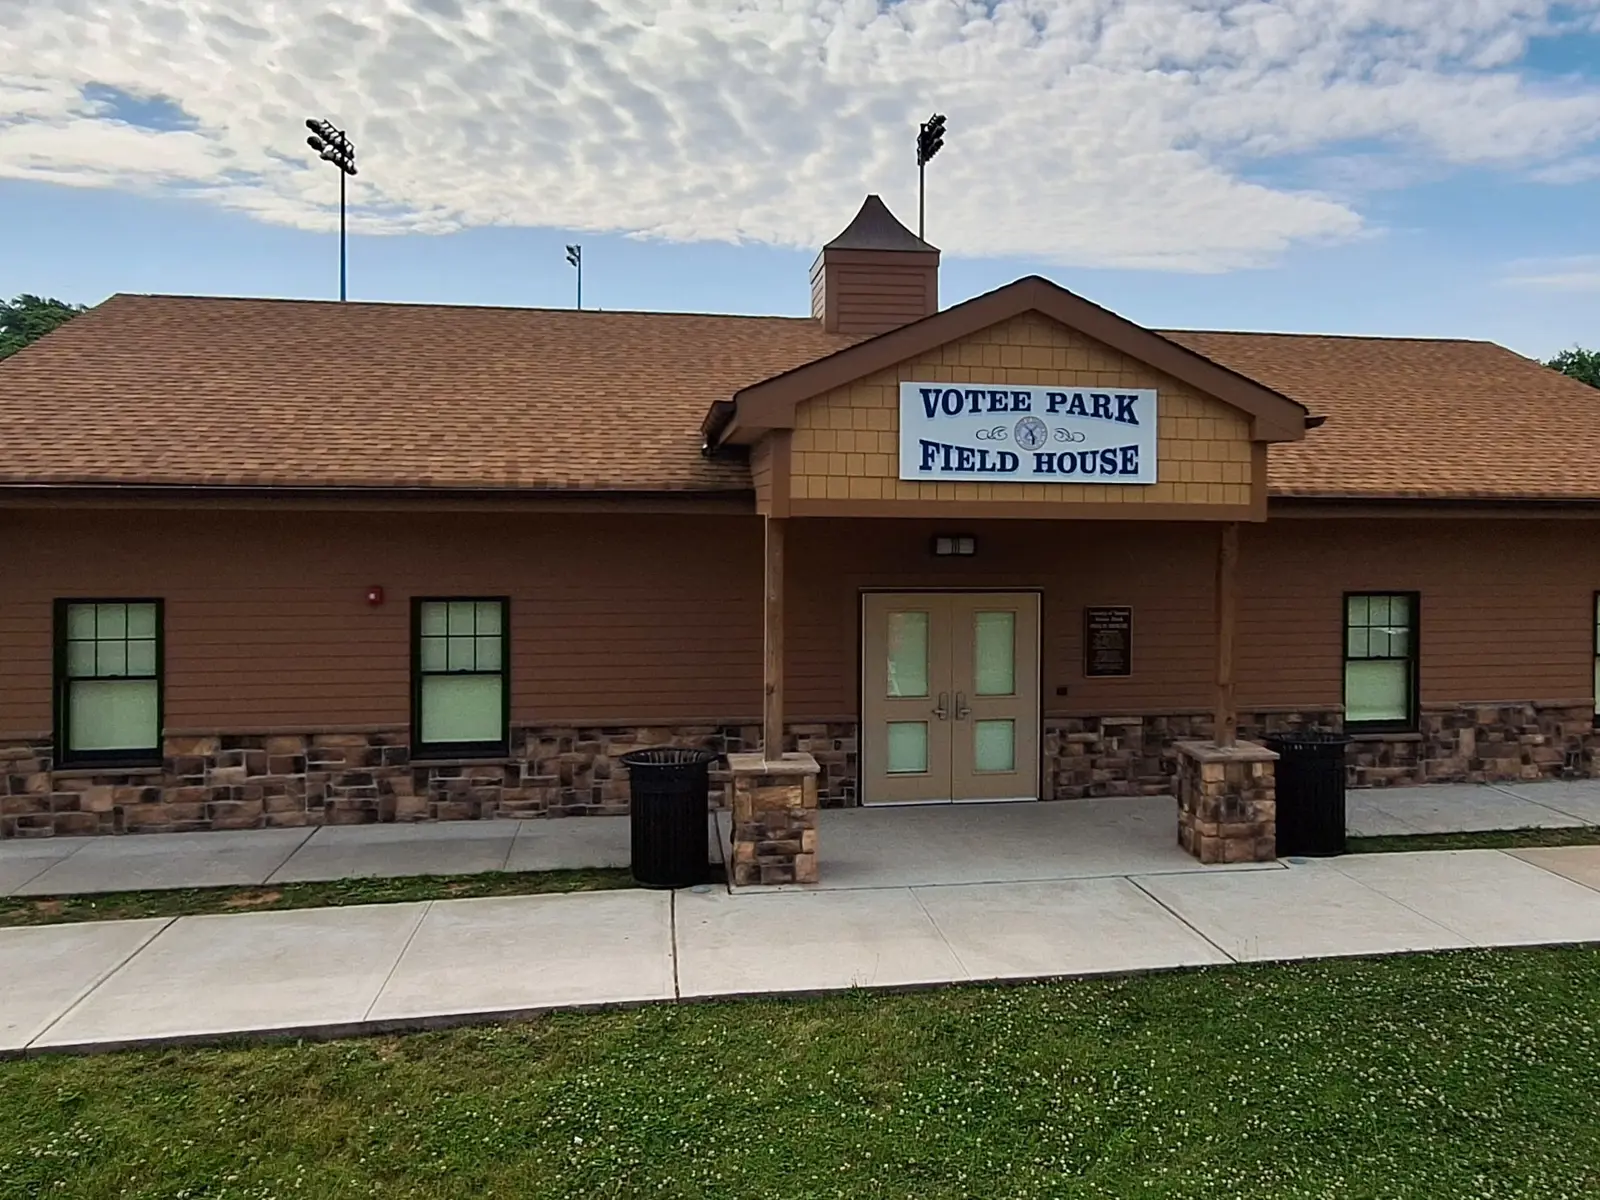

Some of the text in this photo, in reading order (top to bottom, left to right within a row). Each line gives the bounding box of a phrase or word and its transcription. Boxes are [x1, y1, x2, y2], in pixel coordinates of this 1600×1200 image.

[919, 388, 1139, 425] VOTEE PARK
[919, 439, 1139, 475] FIELD HOUSE
